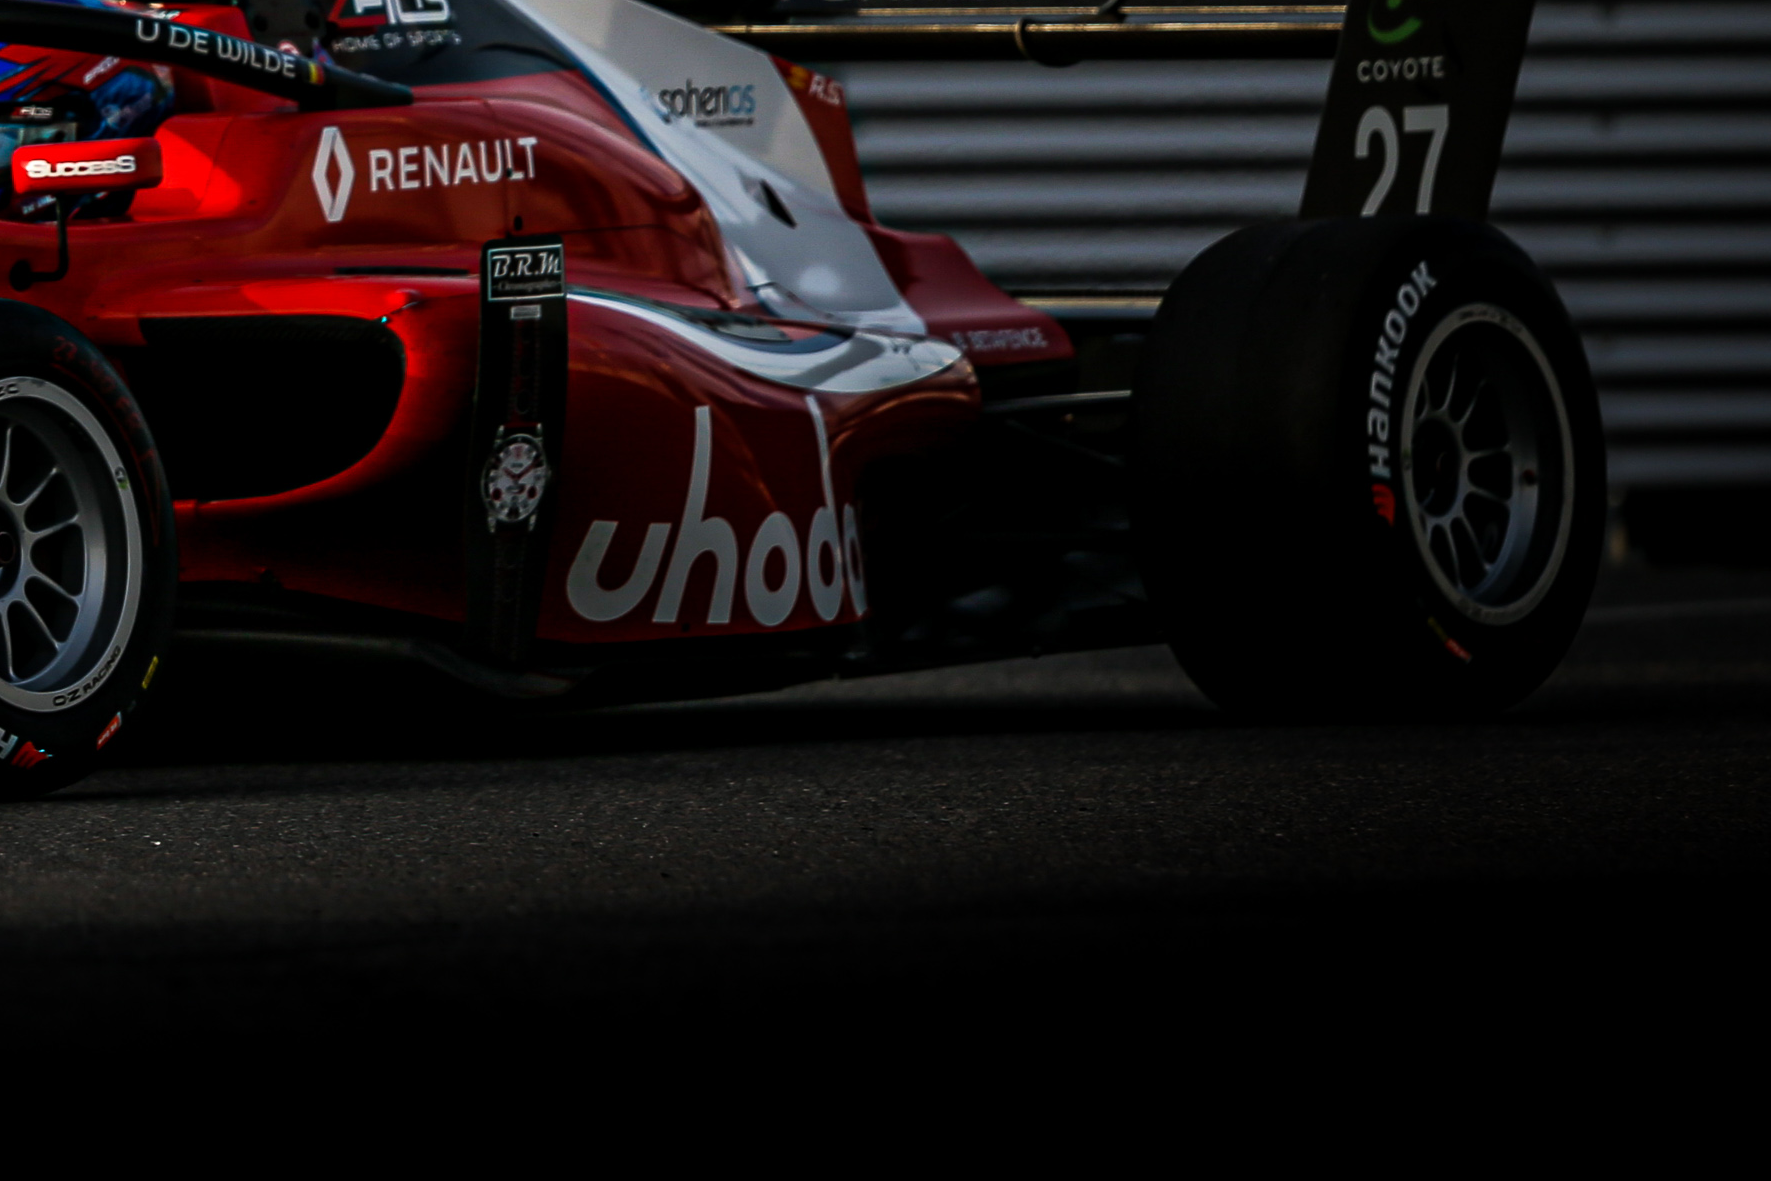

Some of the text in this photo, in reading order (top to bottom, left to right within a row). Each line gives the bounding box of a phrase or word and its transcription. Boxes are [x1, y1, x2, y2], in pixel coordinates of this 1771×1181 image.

[167, 23, 211, 55] DE
[216, 34, 298, 80] WILDE
[330, 34, 381, 53] HOME
[1356, 54, 1445, 84] COYOTE
[368, 136, 539, 193] RENAULT
[1353, 103, 1451, 219] 27
[53, 645, 122, 707] OZ RACING
